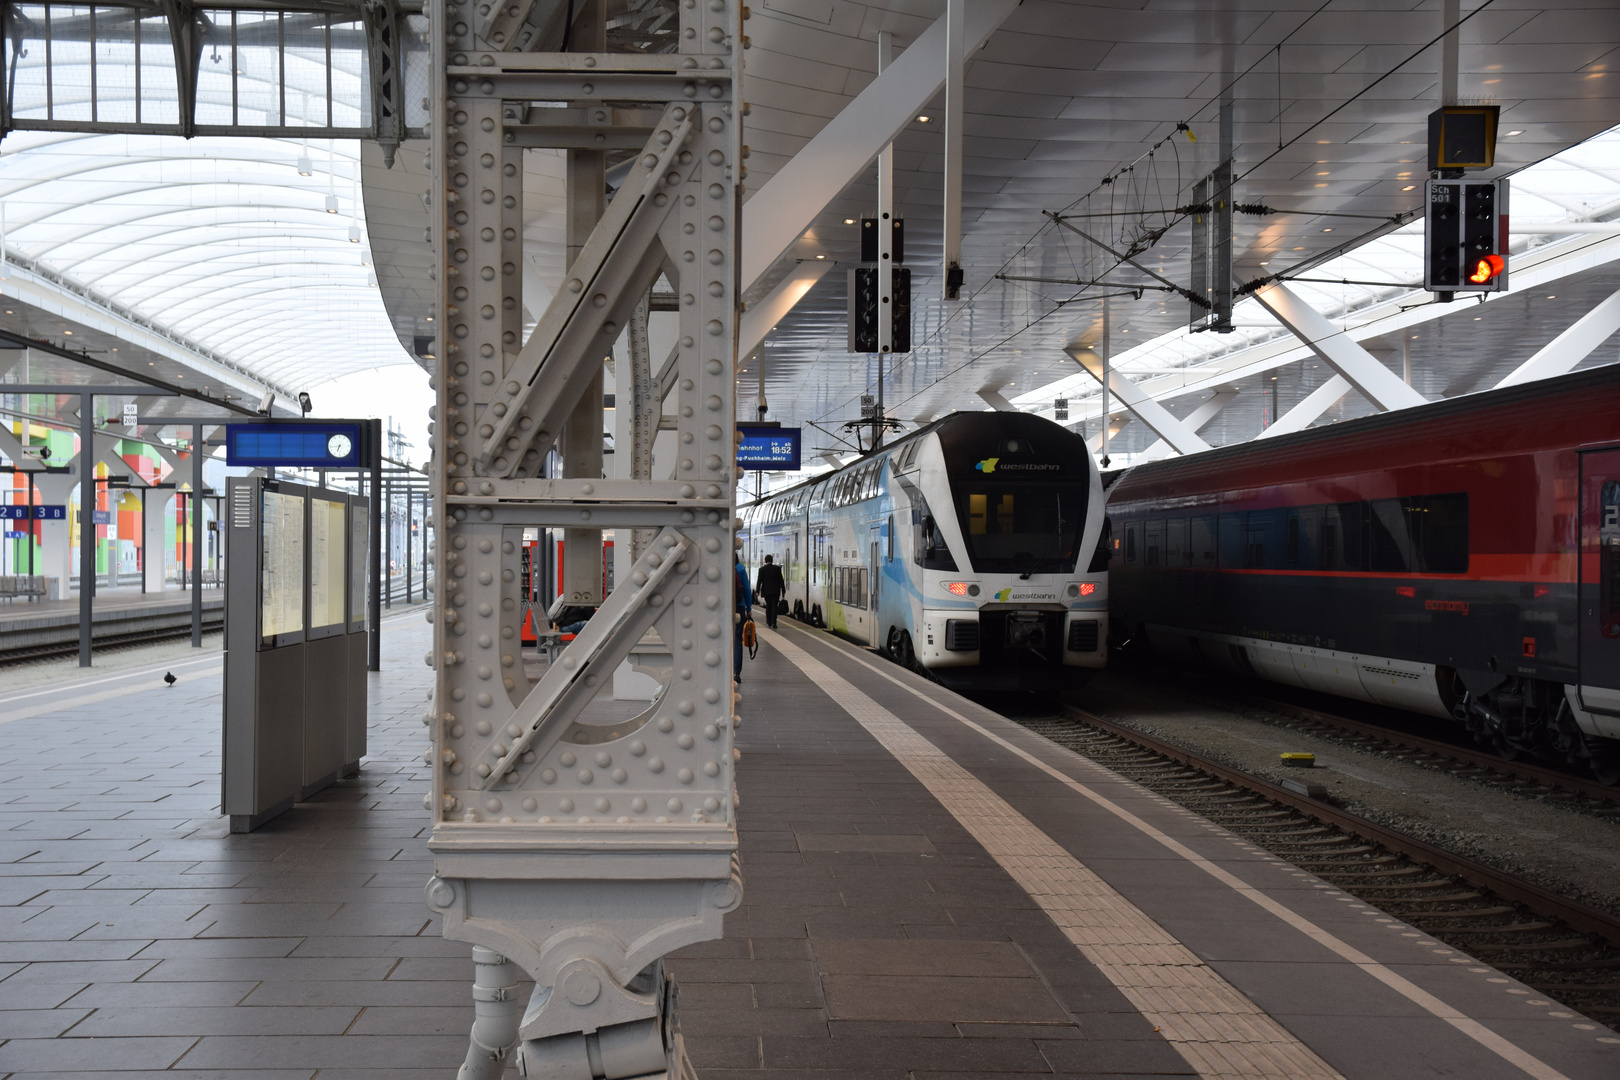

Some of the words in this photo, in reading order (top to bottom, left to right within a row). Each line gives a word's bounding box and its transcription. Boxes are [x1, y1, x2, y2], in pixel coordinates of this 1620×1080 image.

[1431, 194, 1450, 203] 501
[771, 446, 792, 454] 18:52
[1000, 463, 1060, 471] westbahn
[0, 507, 8, 518] 2
[16, 509, 22, 518] B
[38, 507, 46, 518] 3
[54, 509, 61, 518] B
[1604, 505, 1619, 528] 2
[1424, 599, 1470, 616] economy
